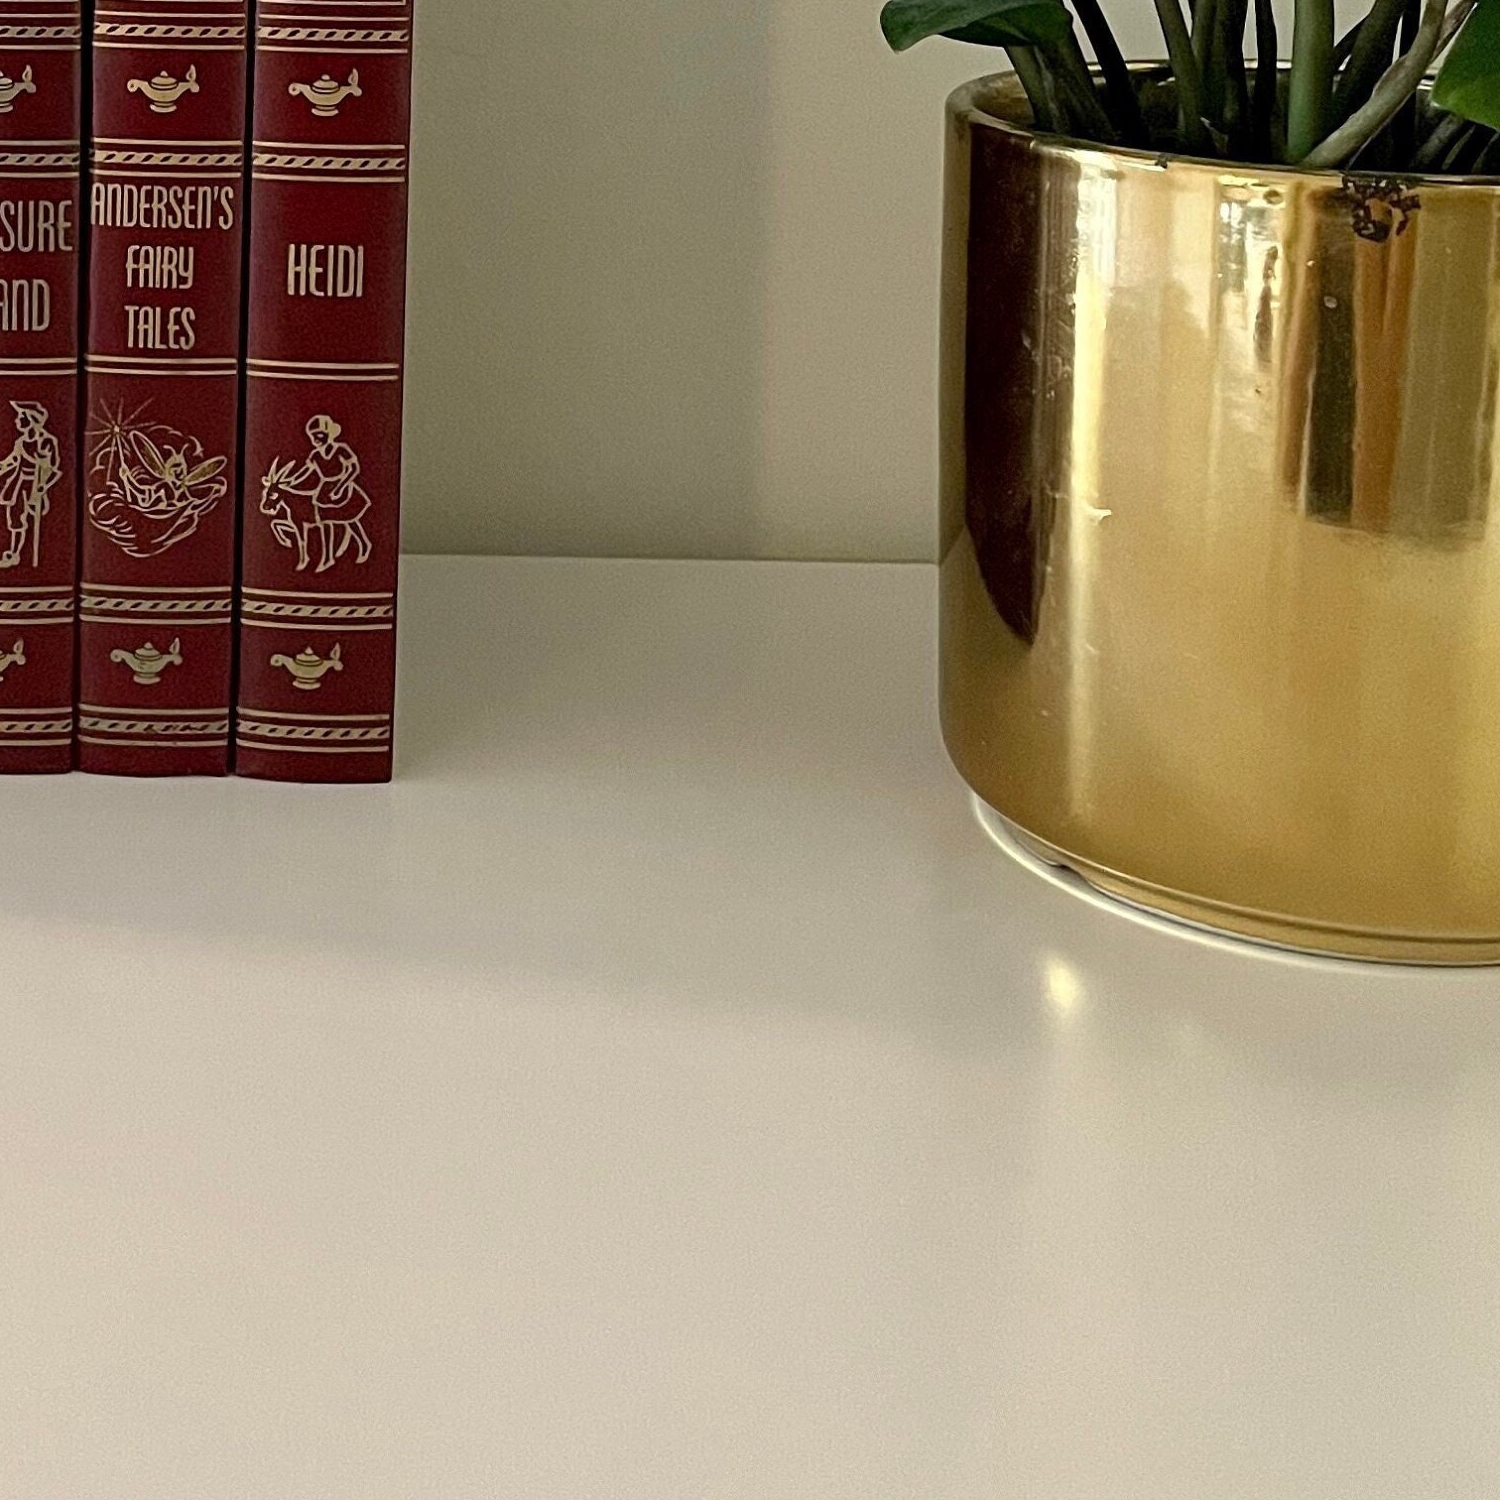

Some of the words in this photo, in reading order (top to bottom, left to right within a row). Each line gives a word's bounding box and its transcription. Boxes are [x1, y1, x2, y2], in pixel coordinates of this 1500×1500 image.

[91, 182, 233, 229] ANDERSEN'S
[126, 245, 193, 288] FAIRY
[288, 244, 363, 296] HEIDI
[125, 306, 195, 349] TALES
